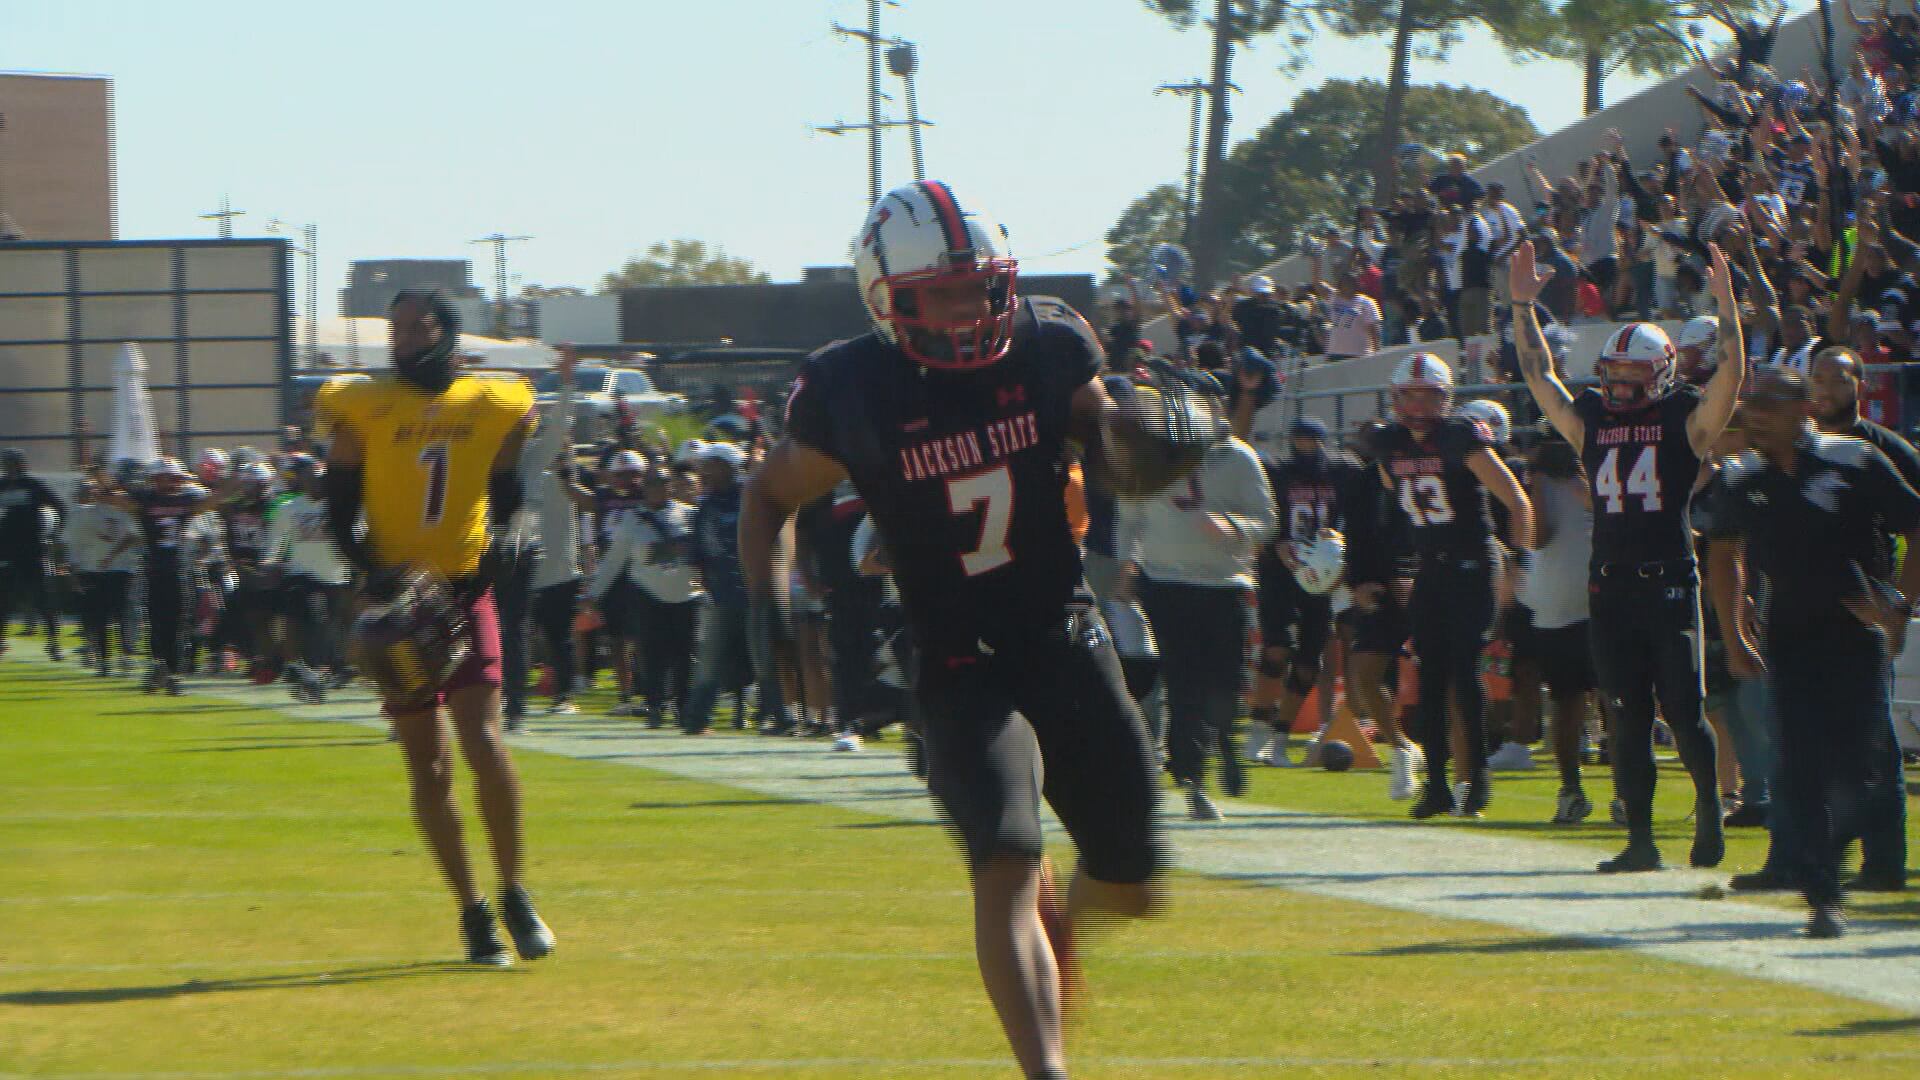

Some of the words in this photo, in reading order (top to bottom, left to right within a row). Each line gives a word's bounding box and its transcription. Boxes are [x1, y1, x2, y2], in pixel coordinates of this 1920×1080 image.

[901, 431, 984, 482] JACKSON
[986, 411, 1039, 458] STATE
[1633, 424, 1664, 442] STATE
[415, 440, 450, 527] 1
[1595, 445, 1664, 514] 44
[944, 463, 1015, 577] 7
